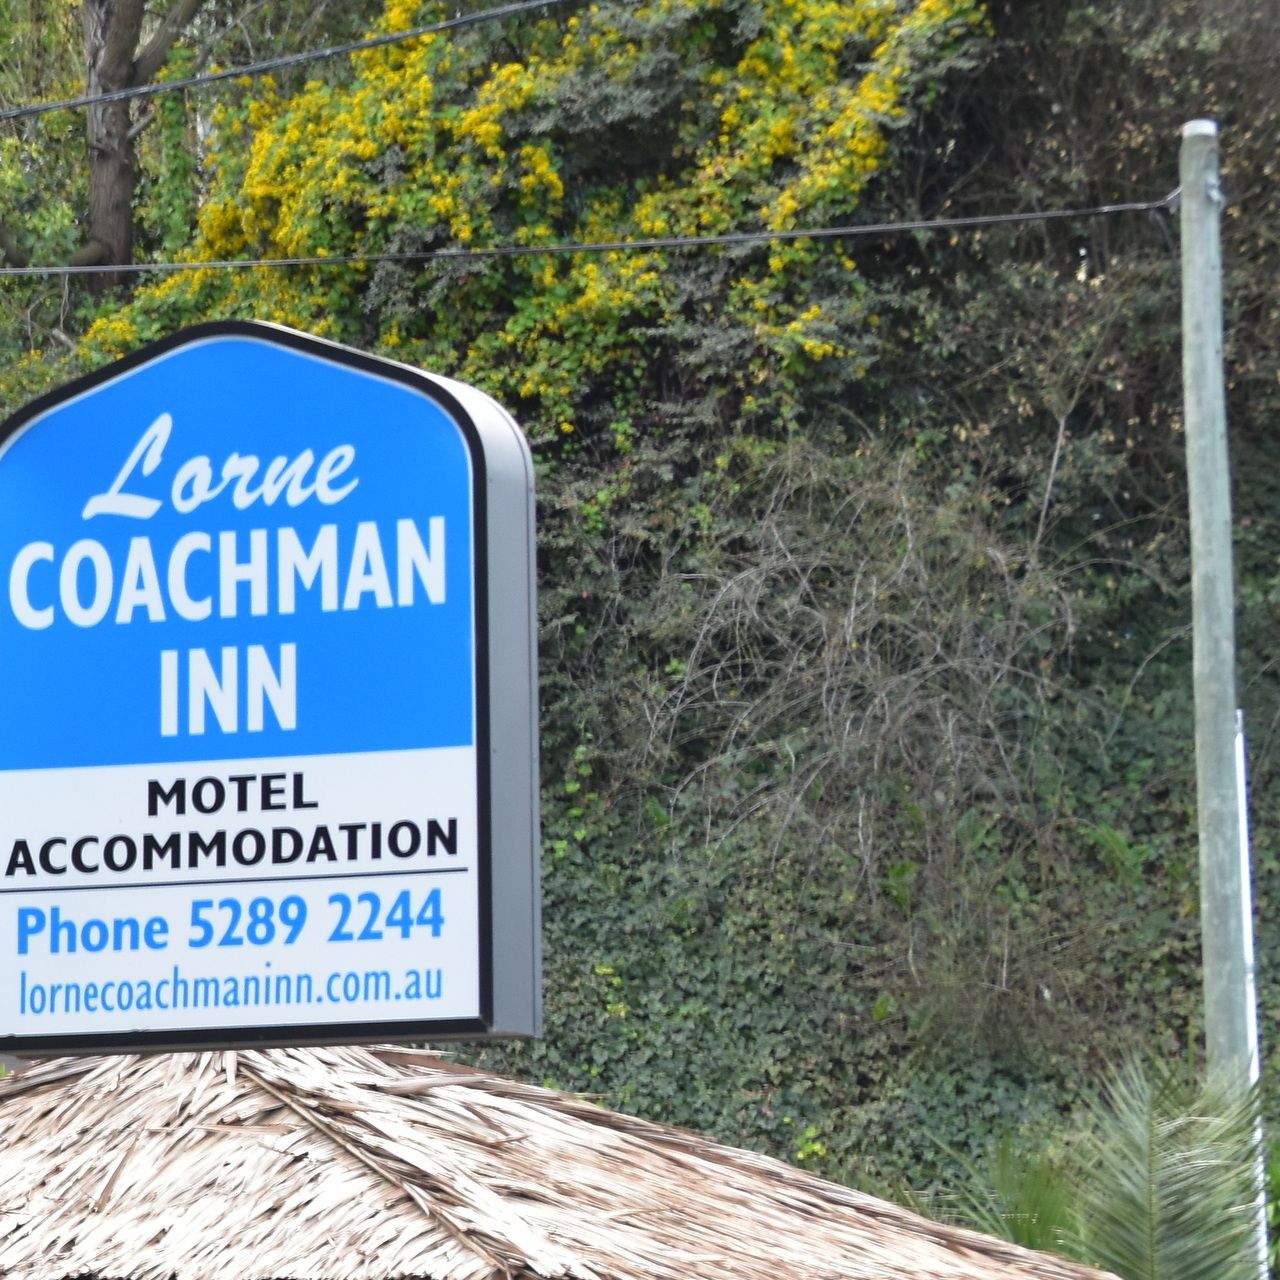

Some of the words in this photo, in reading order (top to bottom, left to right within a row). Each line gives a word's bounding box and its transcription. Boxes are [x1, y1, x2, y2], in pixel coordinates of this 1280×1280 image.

[81, 412, 360, 521] Lorne
[8, 516, 447, 630] COACHMAN
[159, 643, 298, 738] INN
[147, 772, 319, 817] MOTEL
[5, 818, 459, 877] ACCOMMODATION
[17, 906, 170, 957] Phone
[188, 894, 309, 949] 5289
[327, 887, 445, 943] 2244
[18, 965, 443, 1016] lornecoachmaninn.com.au
